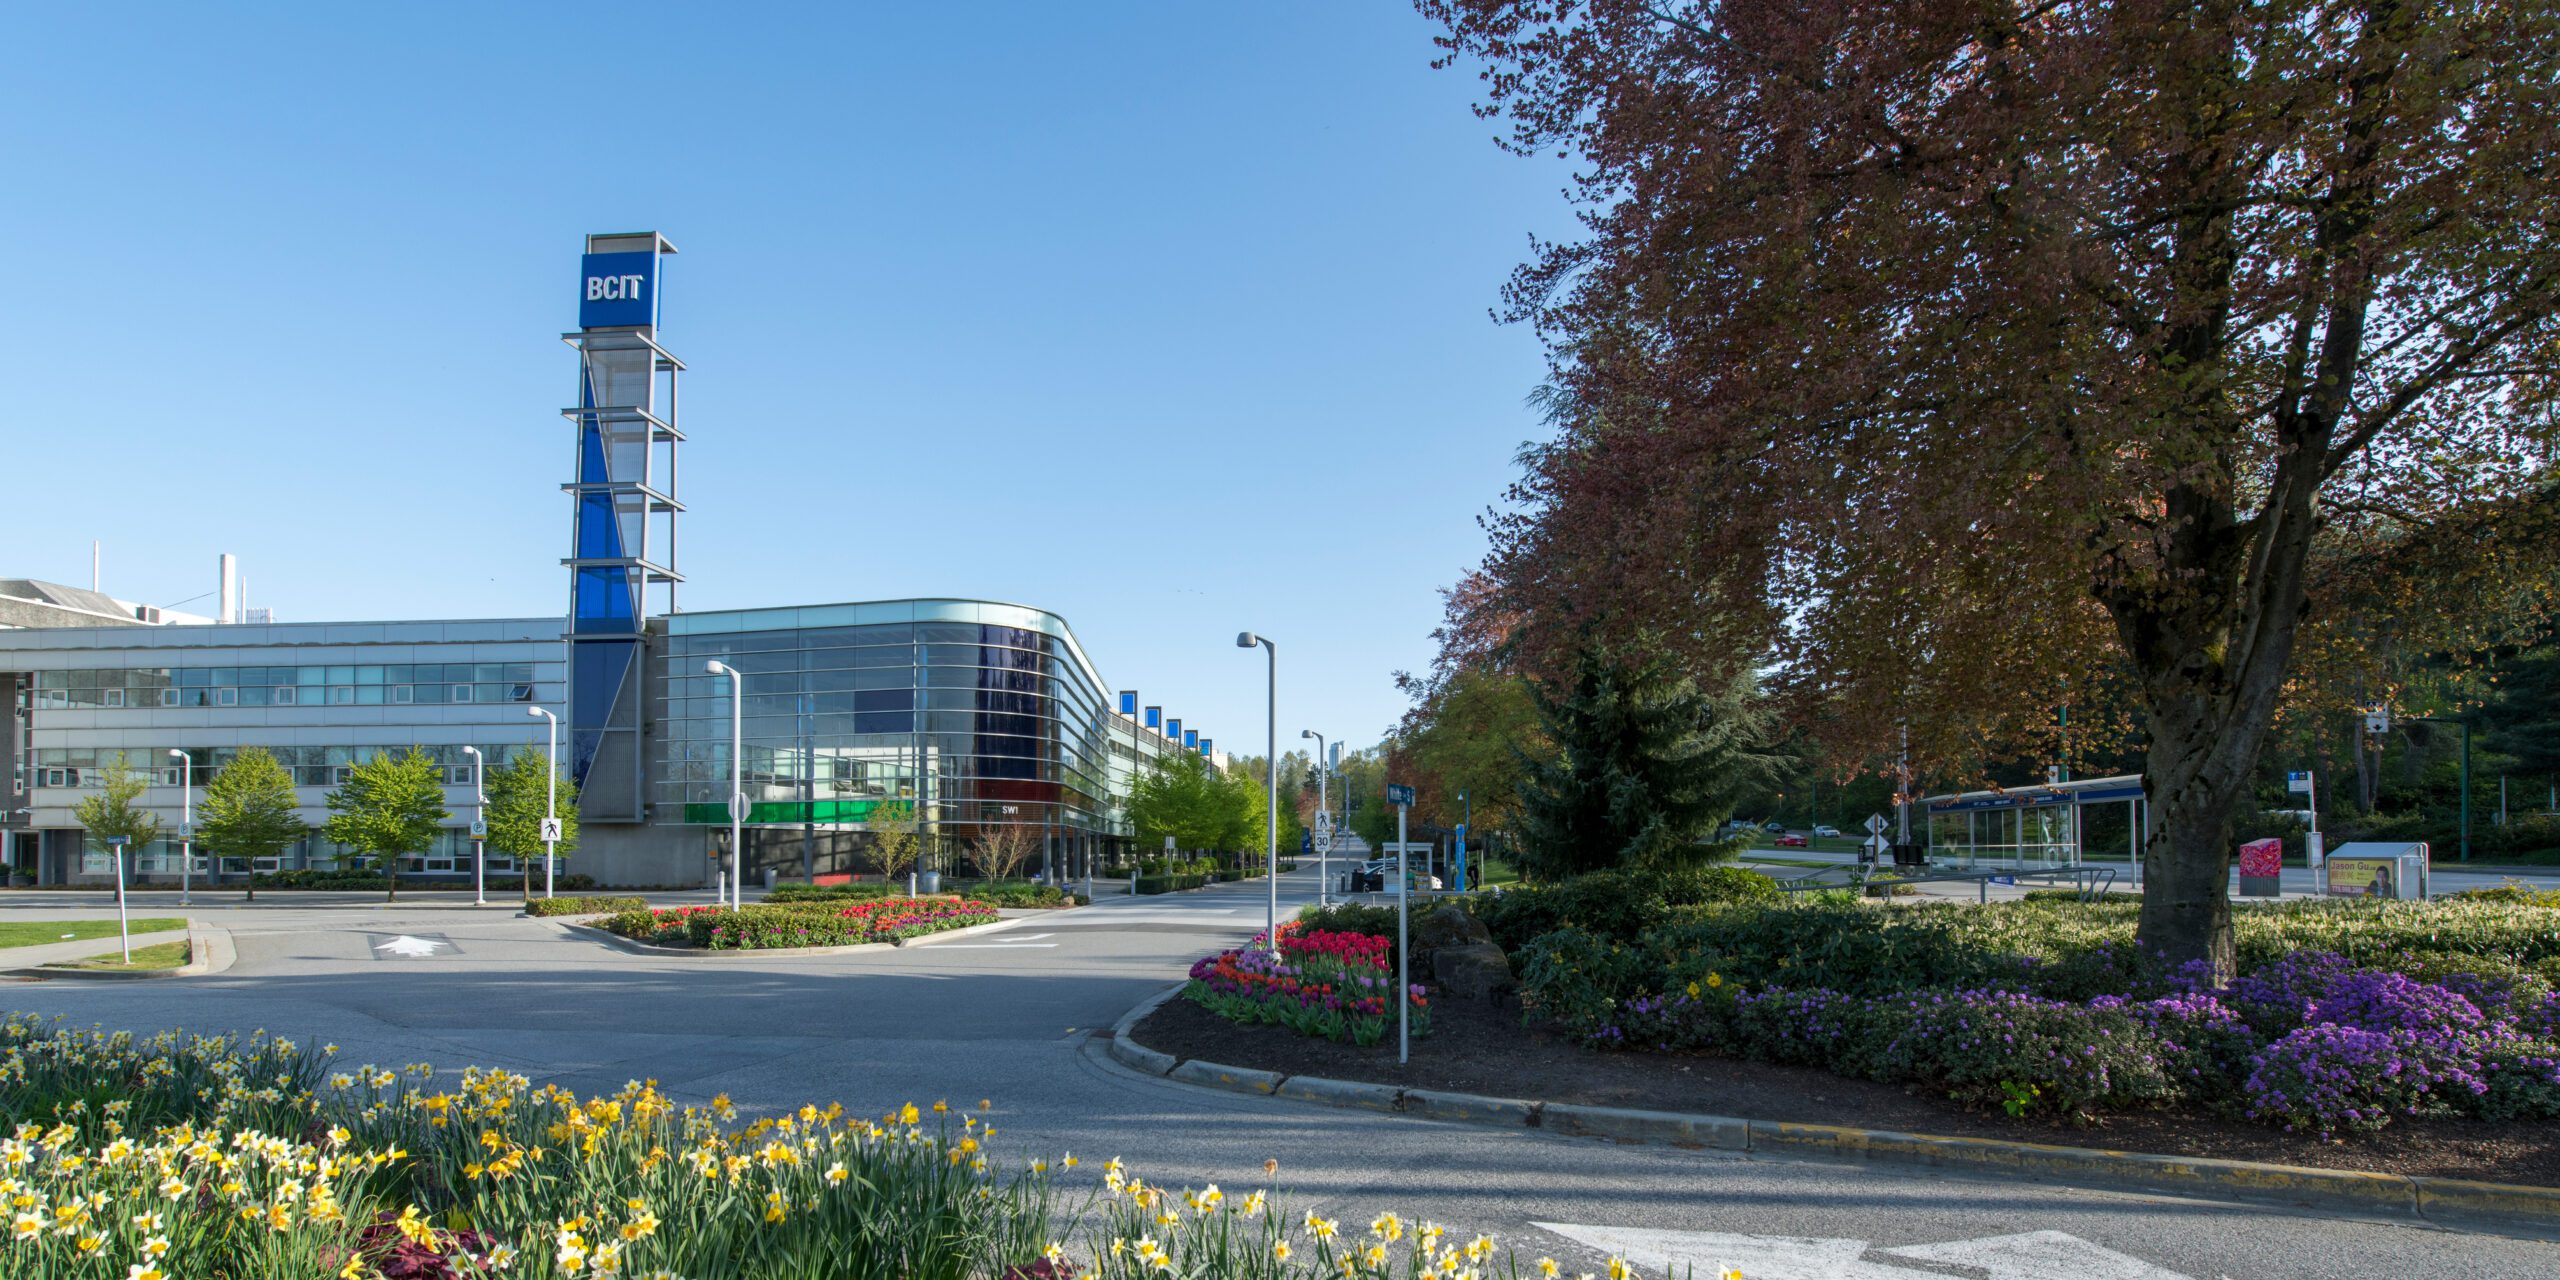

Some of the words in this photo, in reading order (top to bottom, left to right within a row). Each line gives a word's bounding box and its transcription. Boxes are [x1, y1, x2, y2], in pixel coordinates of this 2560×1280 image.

[587, 275, 643, 300] BCIT
[1002, 805, 1018, 815] SW1
[1317, 837, 1328, 846] 30
[2332, 862, 2354, 870] Jason
